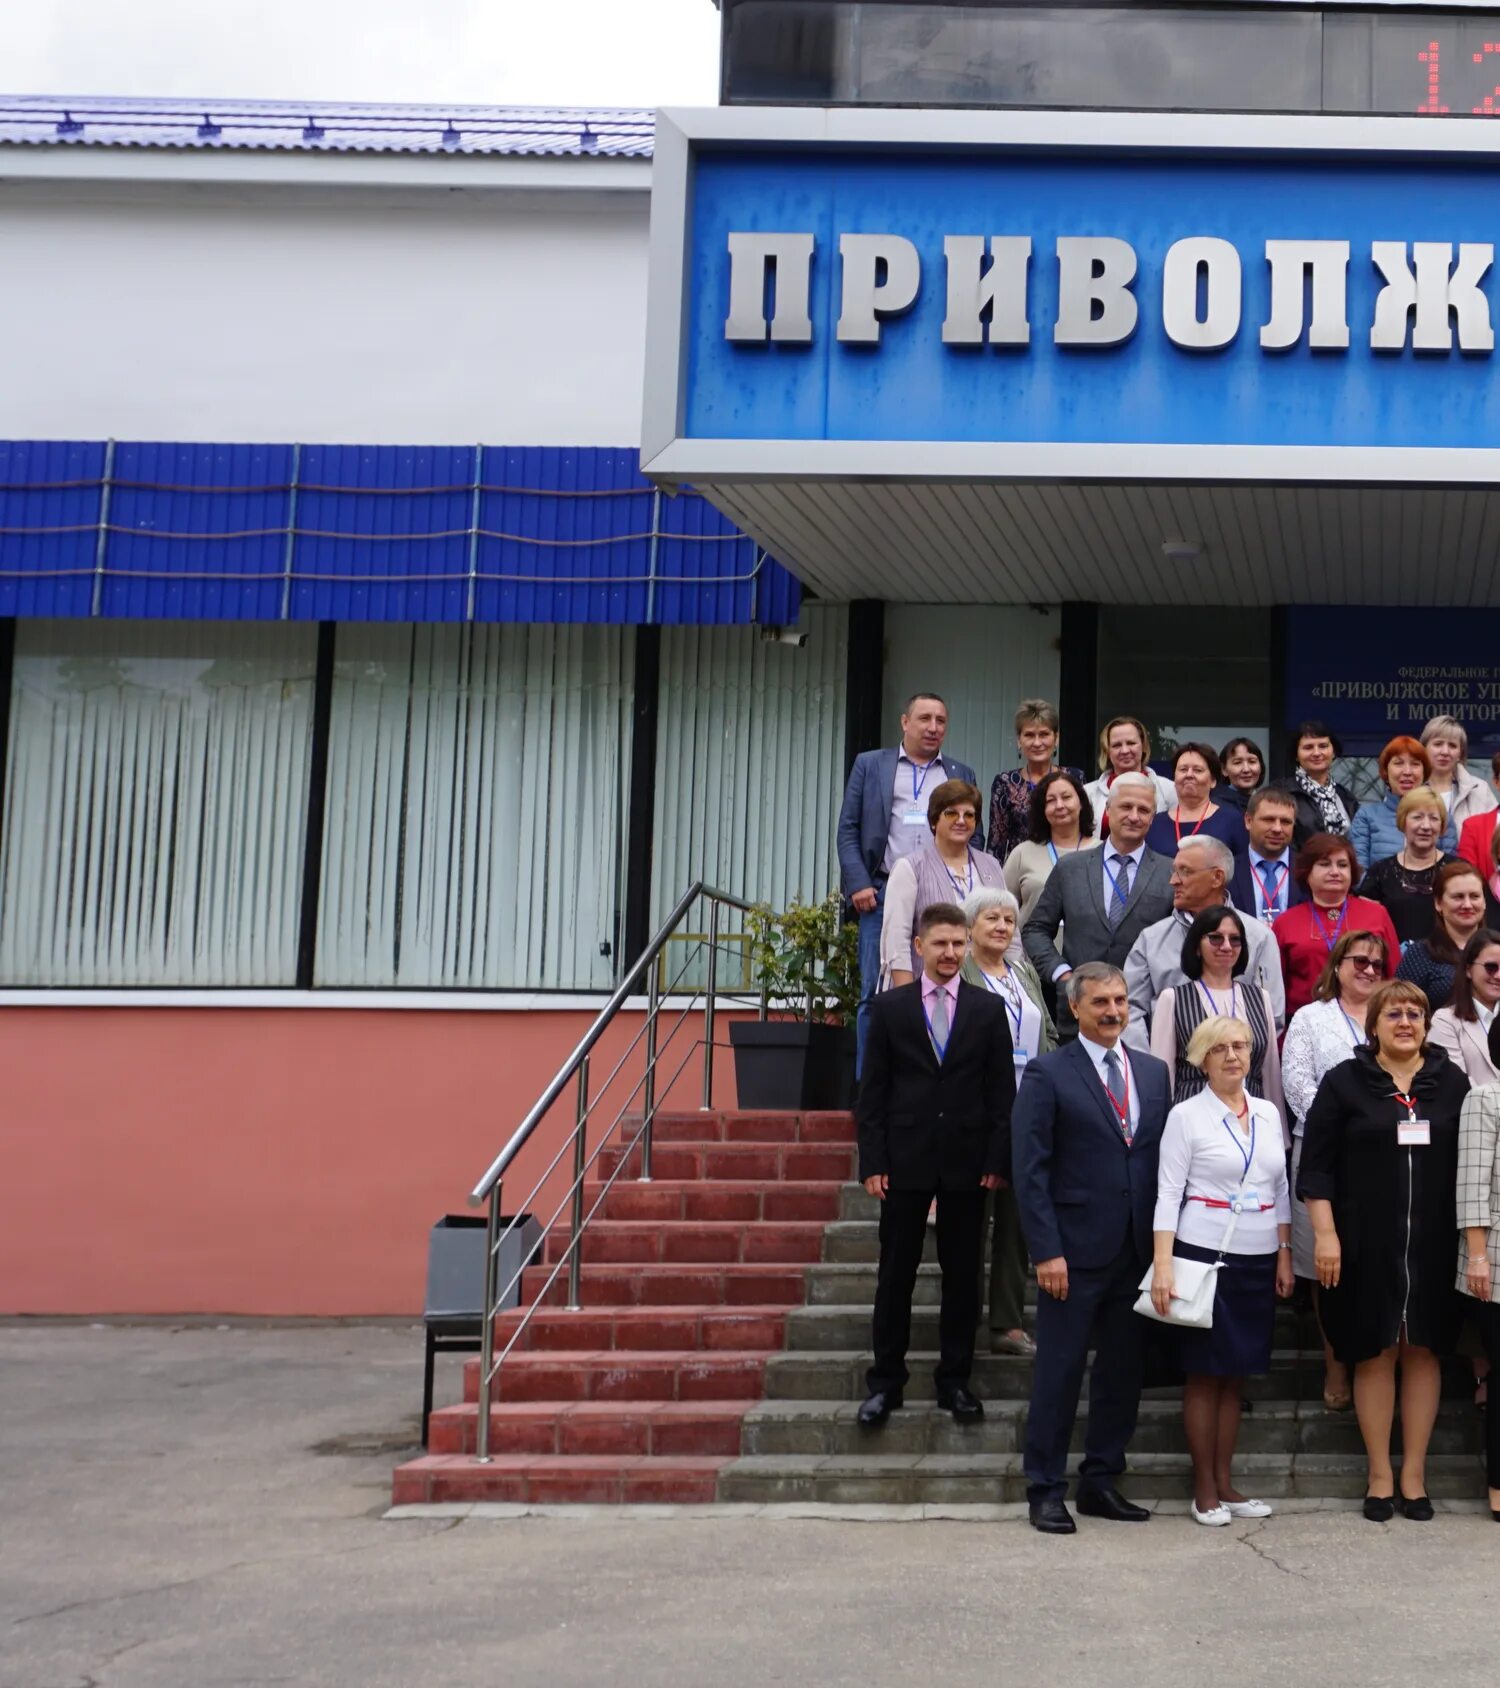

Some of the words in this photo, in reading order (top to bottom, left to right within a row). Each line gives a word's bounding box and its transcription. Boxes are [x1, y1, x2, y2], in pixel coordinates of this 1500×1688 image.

[1398, 666, 1489, 680] ФЕДЕРАЛЬНОЕ
[1311, 681, 1470, 699] «ПРИВОЛЖСКОЕ
[1386, 703, 1400, 720] И
